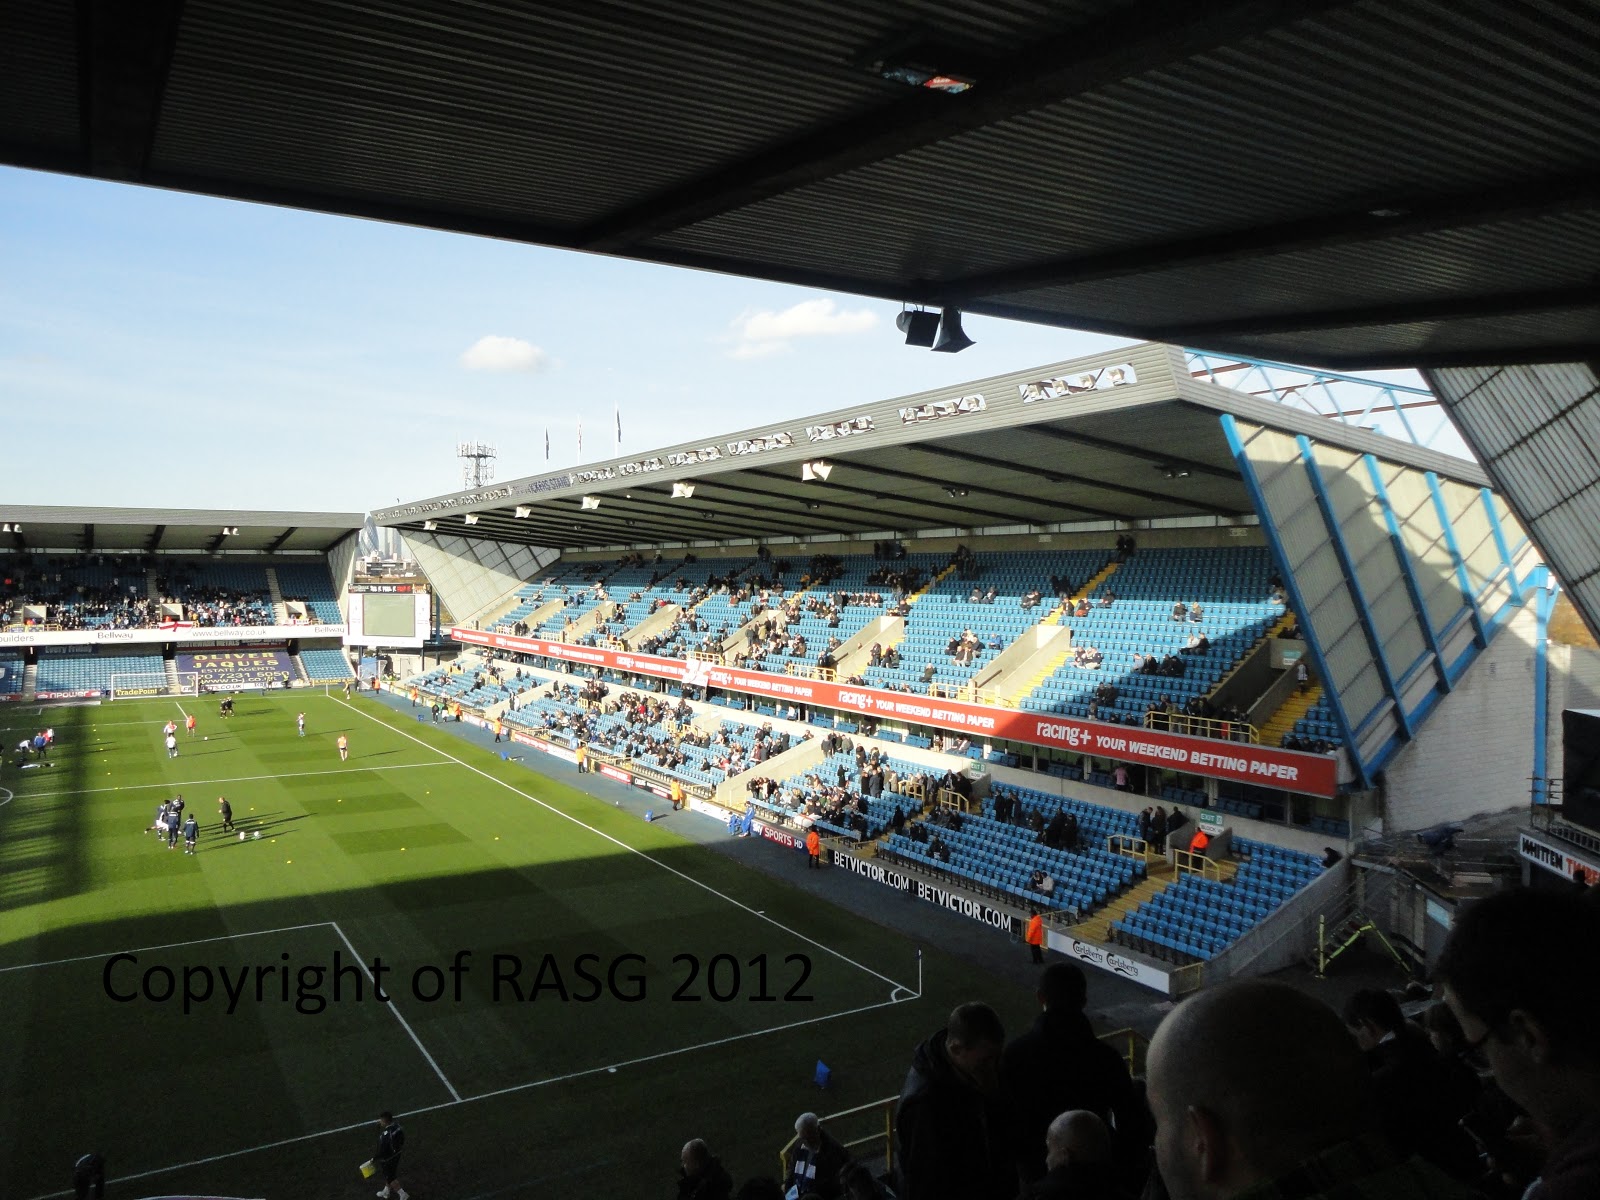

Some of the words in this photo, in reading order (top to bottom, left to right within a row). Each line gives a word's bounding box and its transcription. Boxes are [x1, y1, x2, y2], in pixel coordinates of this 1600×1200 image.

[97, 631, 134, 640] Bellway
[192, 628, 267, 637] www.bellway.co.uk
[315, 626, 345, 634] Bellway
[192, 660, 279, 668] JAQUES
[193, 652, 275, 660] OLIVER
[49, 691, 89, 699] npower
[115, 688, 158, 696] TradePoint
[838, 690, 874, 709] racing+
[876, 699, 895, 712] YOUR
[895, 703, 931, 718] WEEKEND
[931, 709, 966, 724] BETTING
[967, 714, 995, 729] PAPER
[1036, 721, 1092, 747] racing+
[1096, 735, 1127, 752] YOUR
[1129, 741, 1188, 762] WEEKEND
[1189, 752, 1248, 773] BETTING
[1249, 760, 1299, 781] PAPER
[752, 823, 763, 836] sky
[764, 826, 793, 847] SPORTS
[794, 839, 803, 850] HD
[1522, 837, 1564, 871] WHITTEN
[834, 850, 910, 891] BETVICTOR.COM
[917, 881, 1012, 933] BETVICTOR.COM
[1072, 940, 1103, 963] Carlsberg
[1106, 952, 1139, 977] Carlsberg
